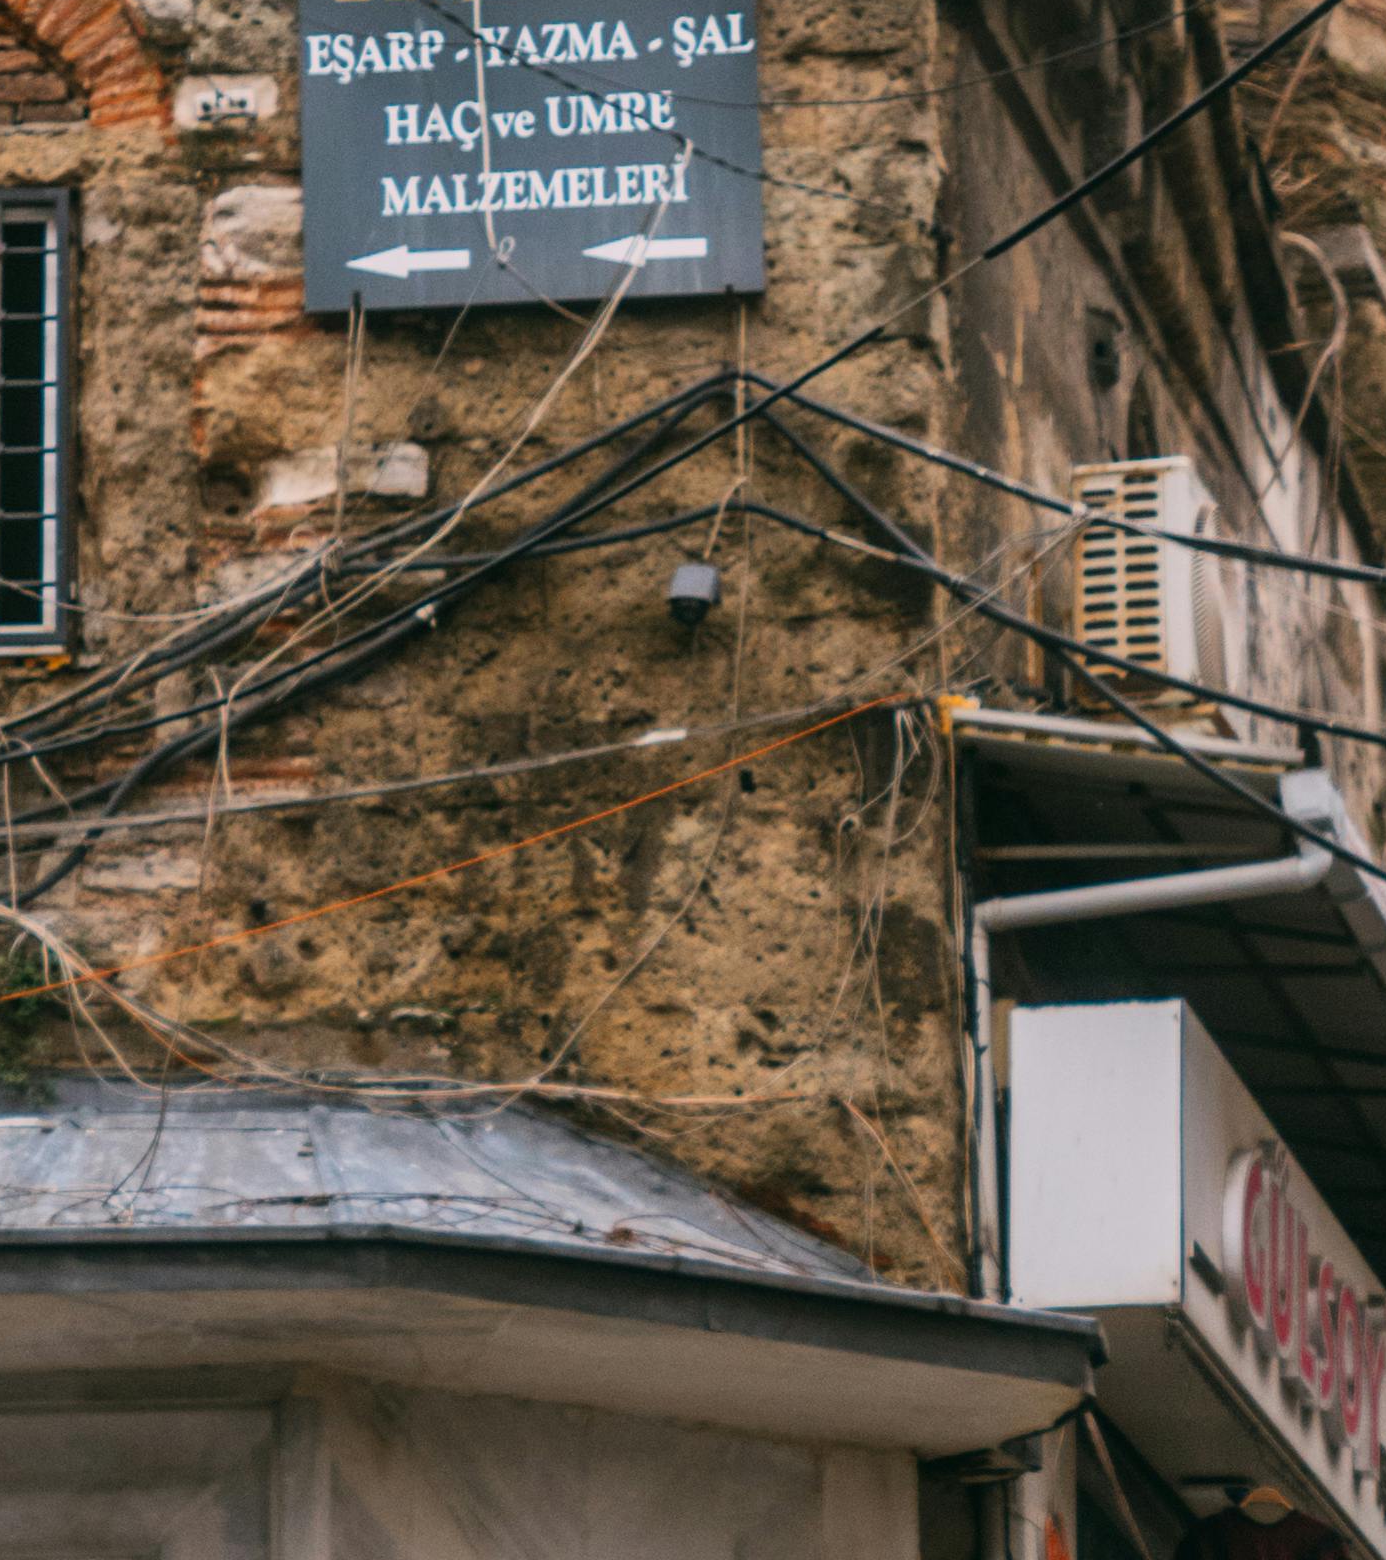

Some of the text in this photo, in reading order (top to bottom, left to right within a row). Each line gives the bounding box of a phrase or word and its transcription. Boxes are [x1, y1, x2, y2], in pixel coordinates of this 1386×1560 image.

[306, 28, 445, 84] EŞARP
[479, 20, 639, 68] YAZMA
[672, 13, 756, 68] ŞAL
[384, 90, 676, 151] HAÇ ve UMRE
[381, 153, 690, 217] MALZEMELERİ
